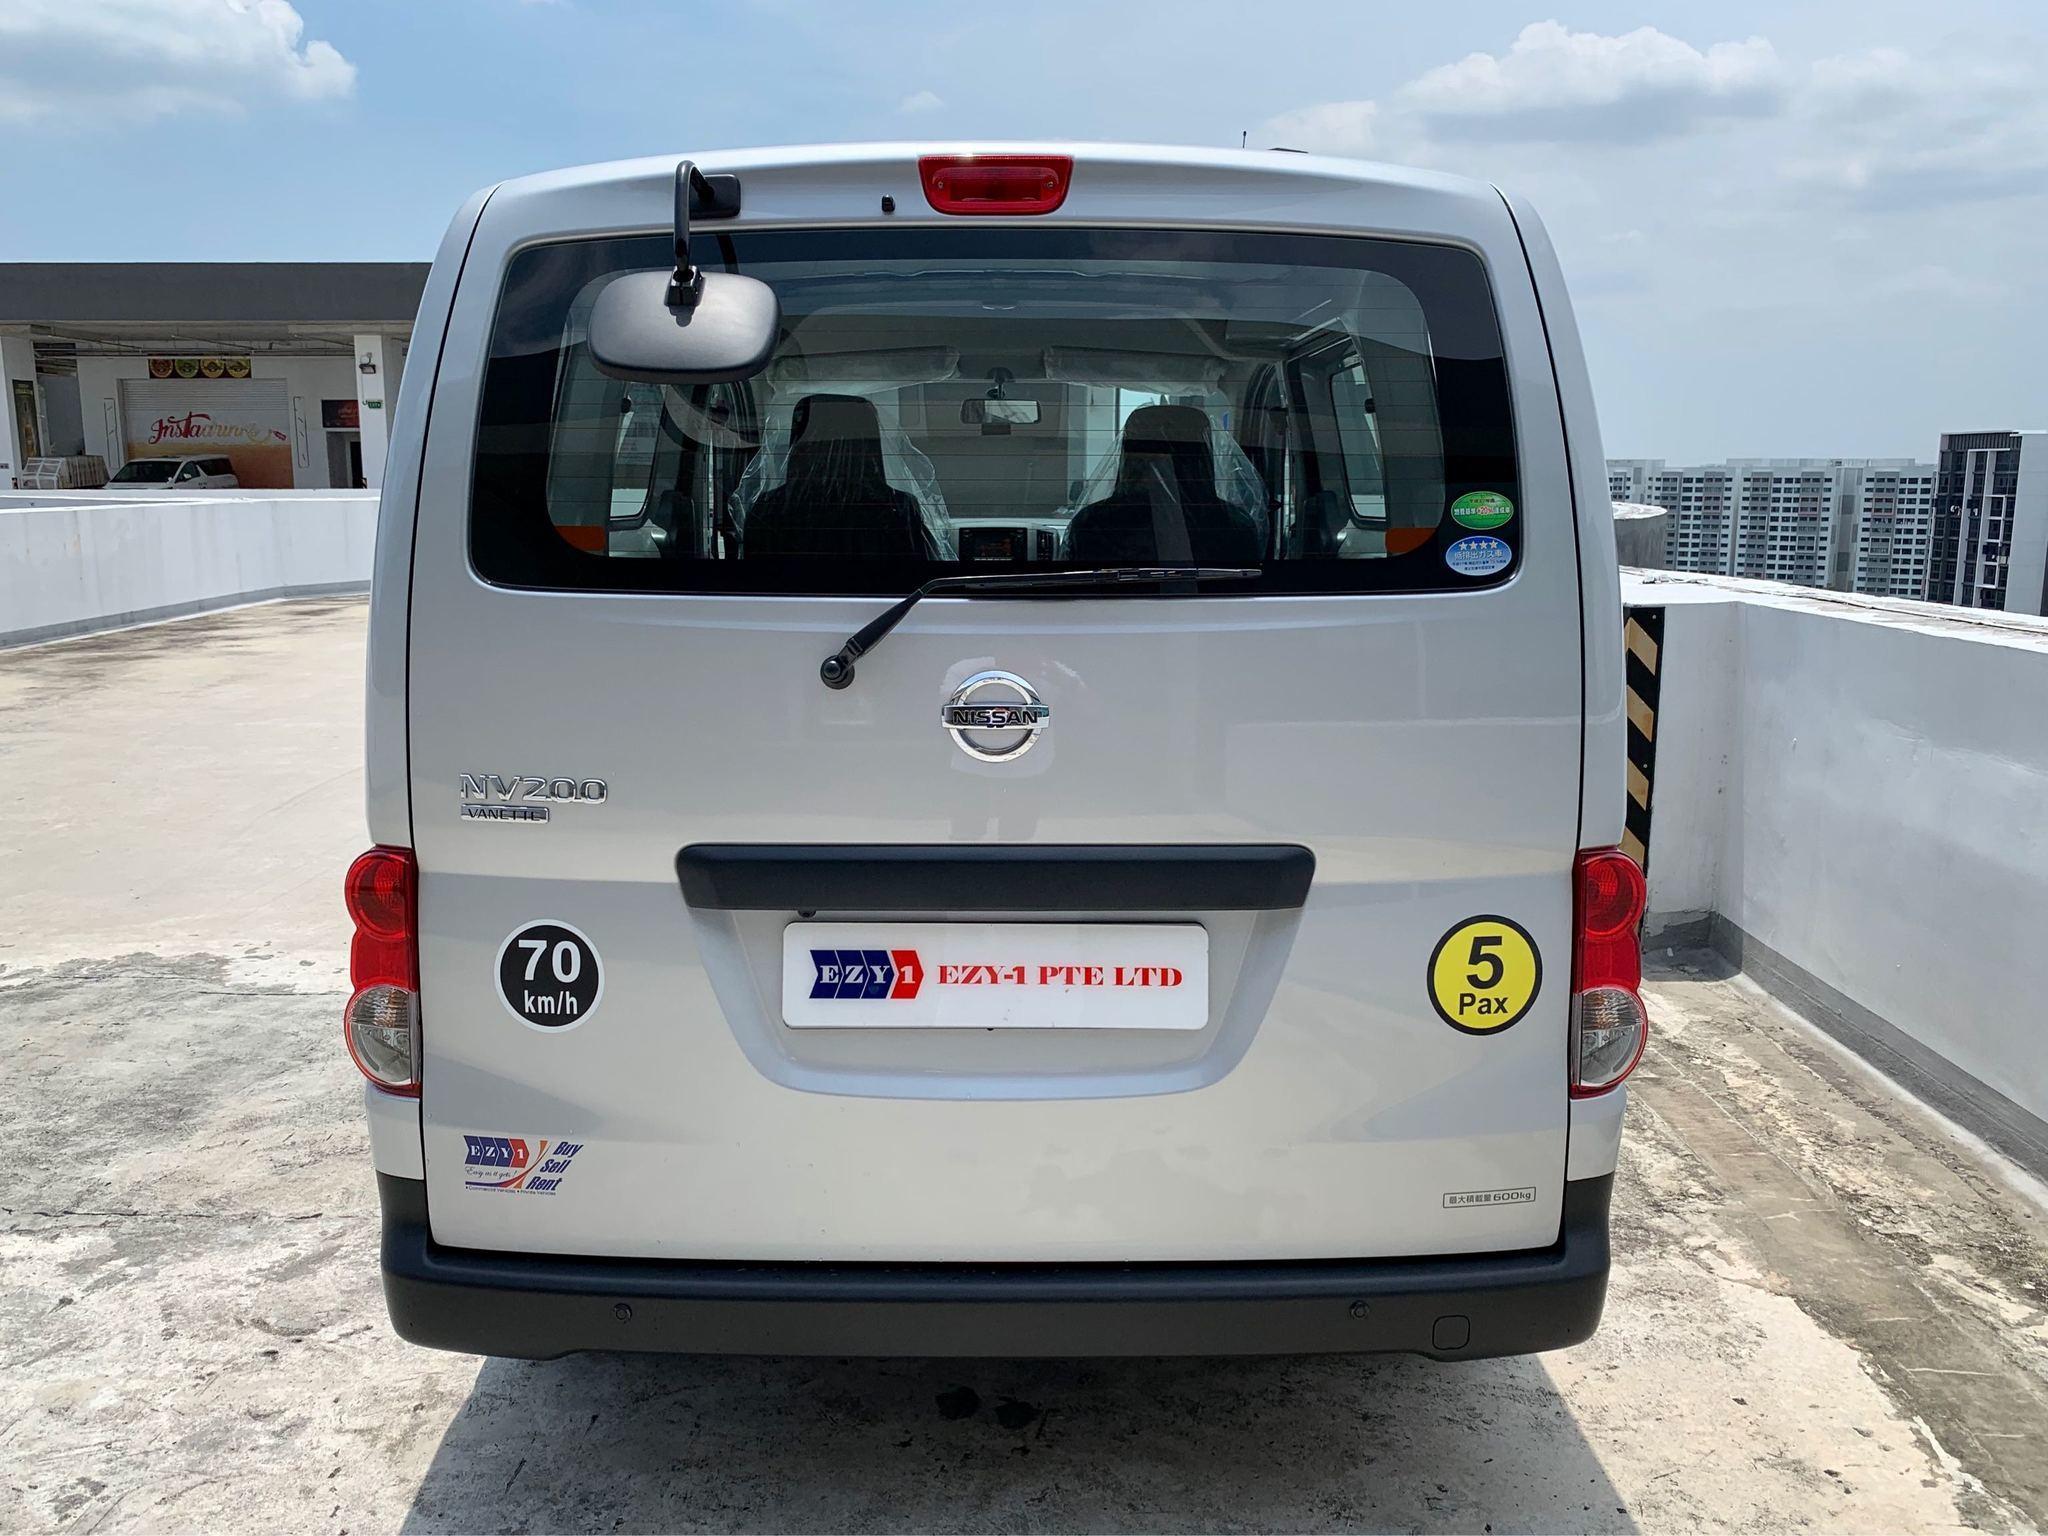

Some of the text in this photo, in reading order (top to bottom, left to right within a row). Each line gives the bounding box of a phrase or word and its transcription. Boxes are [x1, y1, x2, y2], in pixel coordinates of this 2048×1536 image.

[953, 709, 1038, 725] NISSAN
[460, 773, 608, 804] NV200
[468, 807, 541, 821] VANETTE
[518, 939, 581, 983] 70
[1466, 935, 1504, 990] 5
[937, 964, 1183, 987] EZY-1 PTE LTD
[524, 989, 578, 1015] km/h
[1458, 992, 1509, 1015] Pax
[553, 1141, 584, 1158] Buy
[540, 1158, 572, 1173] Sell
[525, 1176, 562, 1191] Rent
[1493, 1192, 1531, 1202] 600kg
